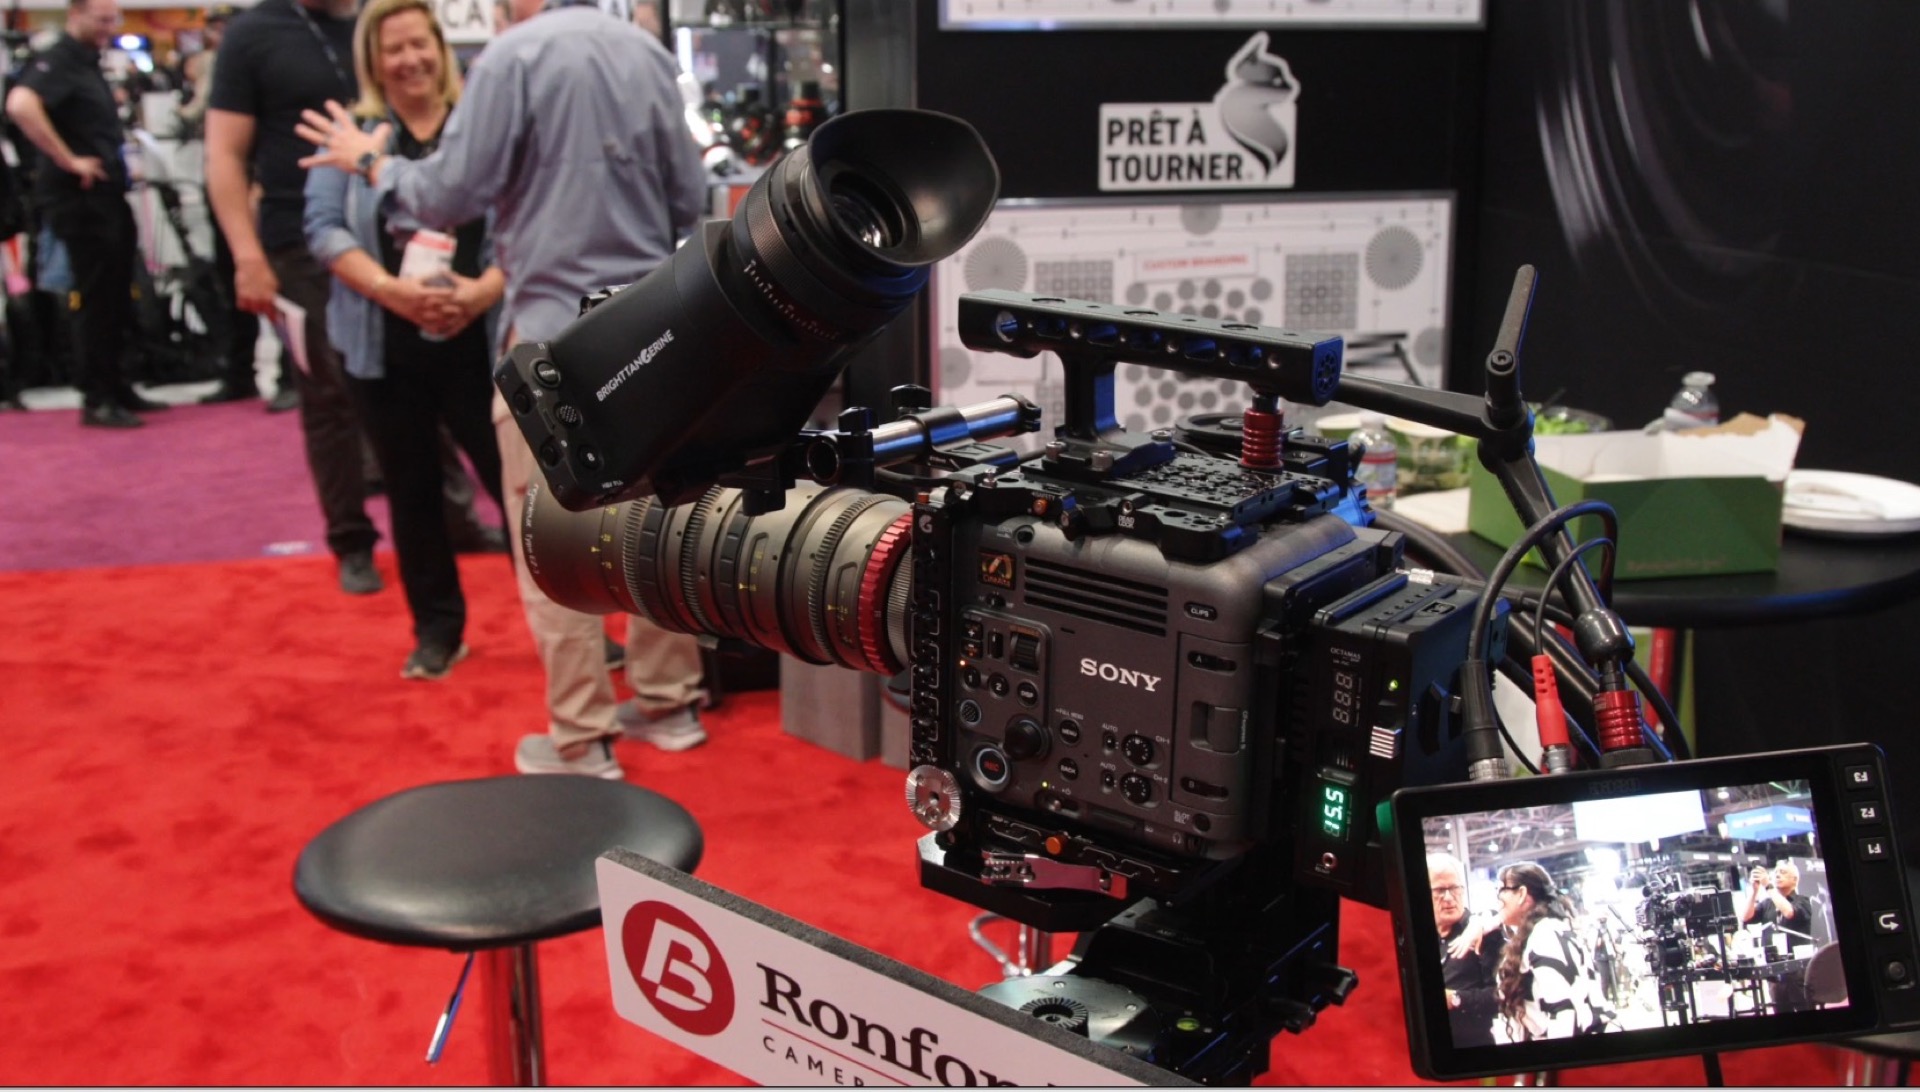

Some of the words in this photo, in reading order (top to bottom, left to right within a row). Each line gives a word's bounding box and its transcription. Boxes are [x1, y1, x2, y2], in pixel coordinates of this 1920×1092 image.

[1107, 109, 1180, 146] PRÊT
[1187, 109, 1206, 145] À
[1107, 154, 1243, 182] TOURNER
[1190, 607, 1209, 618] CLIPS
[1080, 658, 1161, 692] SONY
[1102, 723, 1118, 733] AUTO
[1100, 761, 1116, 771] AUTO
[1853, 771, 1868, 782] F3
[1860, 807, 1875, 818] F2
[1867, 843, 1882, 854] F1
